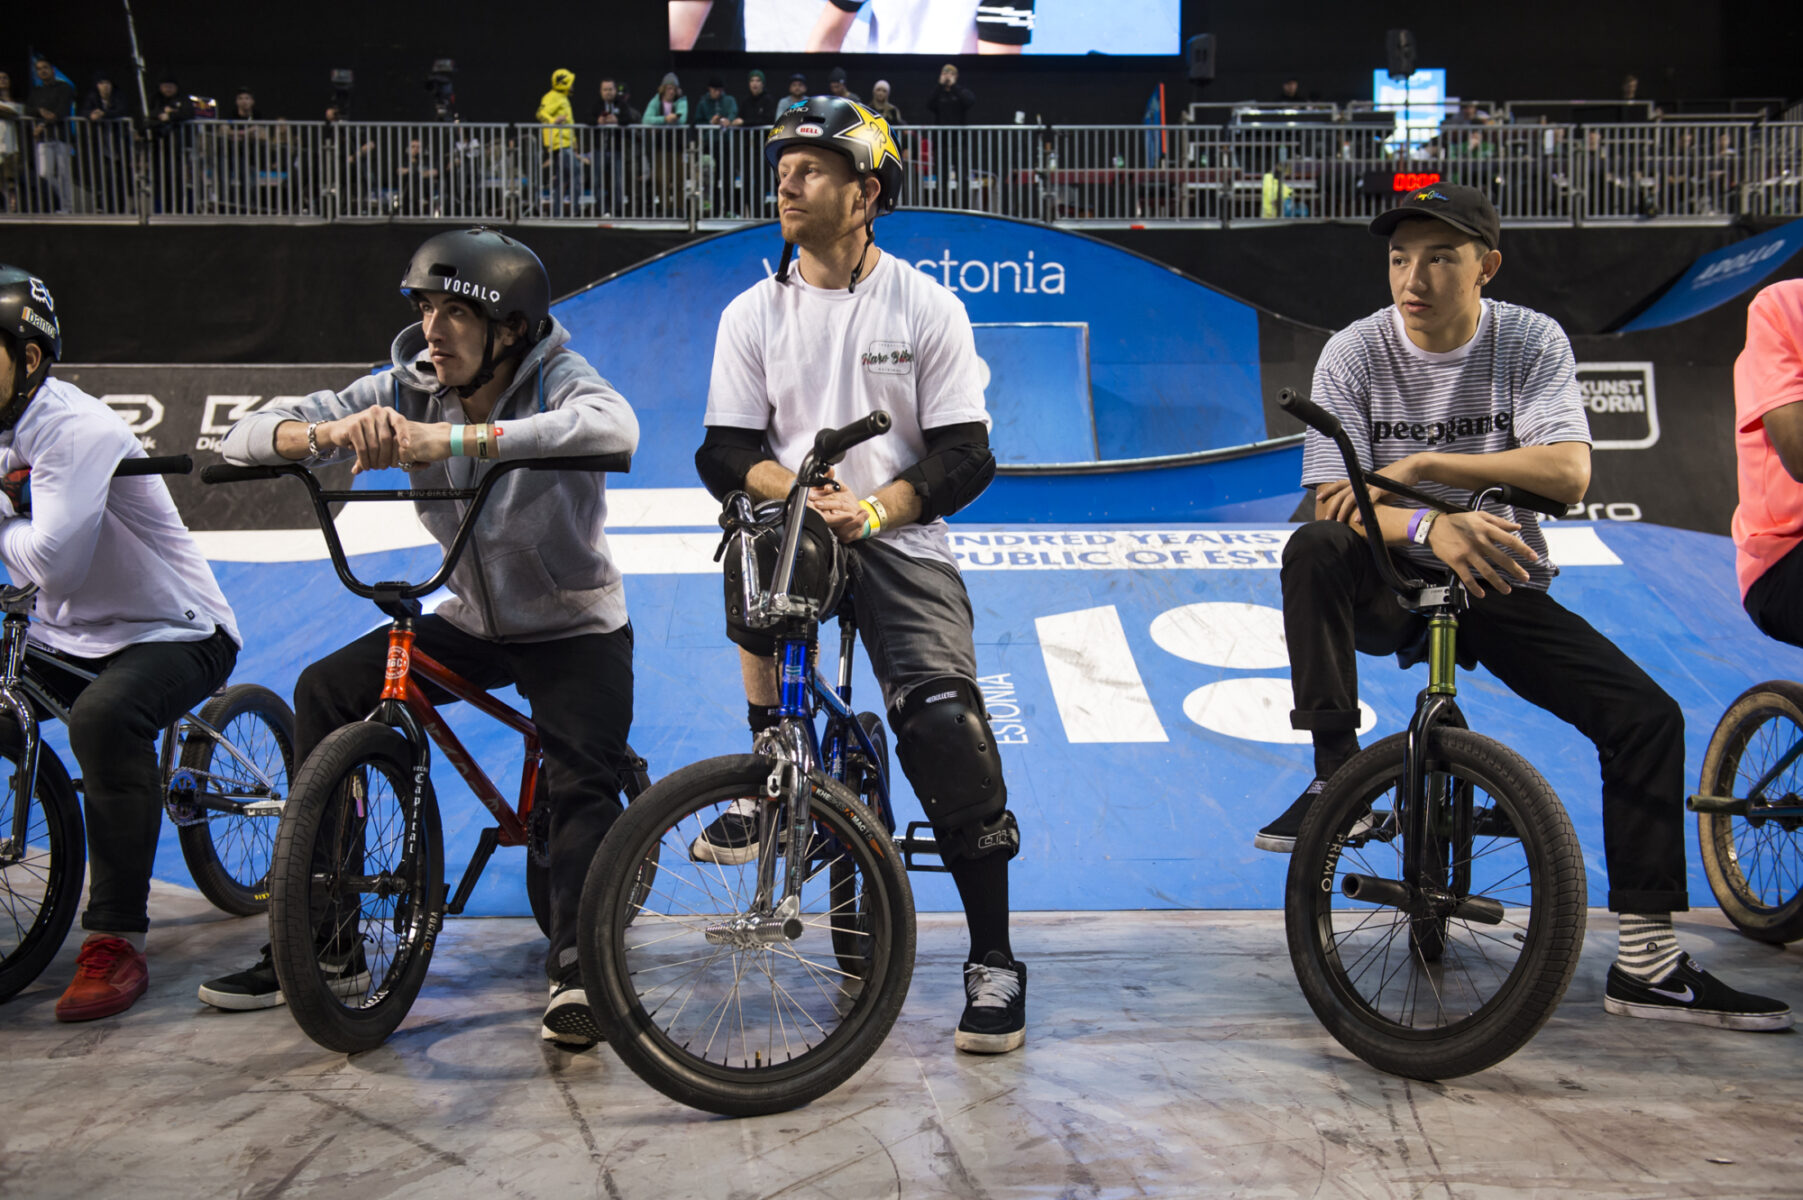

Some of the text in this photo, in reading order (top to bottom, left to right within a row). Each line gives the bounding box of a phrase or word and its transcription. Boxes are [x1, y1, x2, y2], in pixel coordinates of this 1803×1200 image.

[799, 127, 819, 135] BELL
[913, 249, 1065, 294] stonia
[1580, 379, 1642, 394] KUNST
[945, 532, 1281, 546] NDRED YEARS
[1125, 549, 1195, 565] OF
[1208, 549, 1279, 565] EST
[815, 788, 832, 801] KHE
[851, 814, 867, 831] MAC
[1321, 833, 1346, 892] PRIMO
